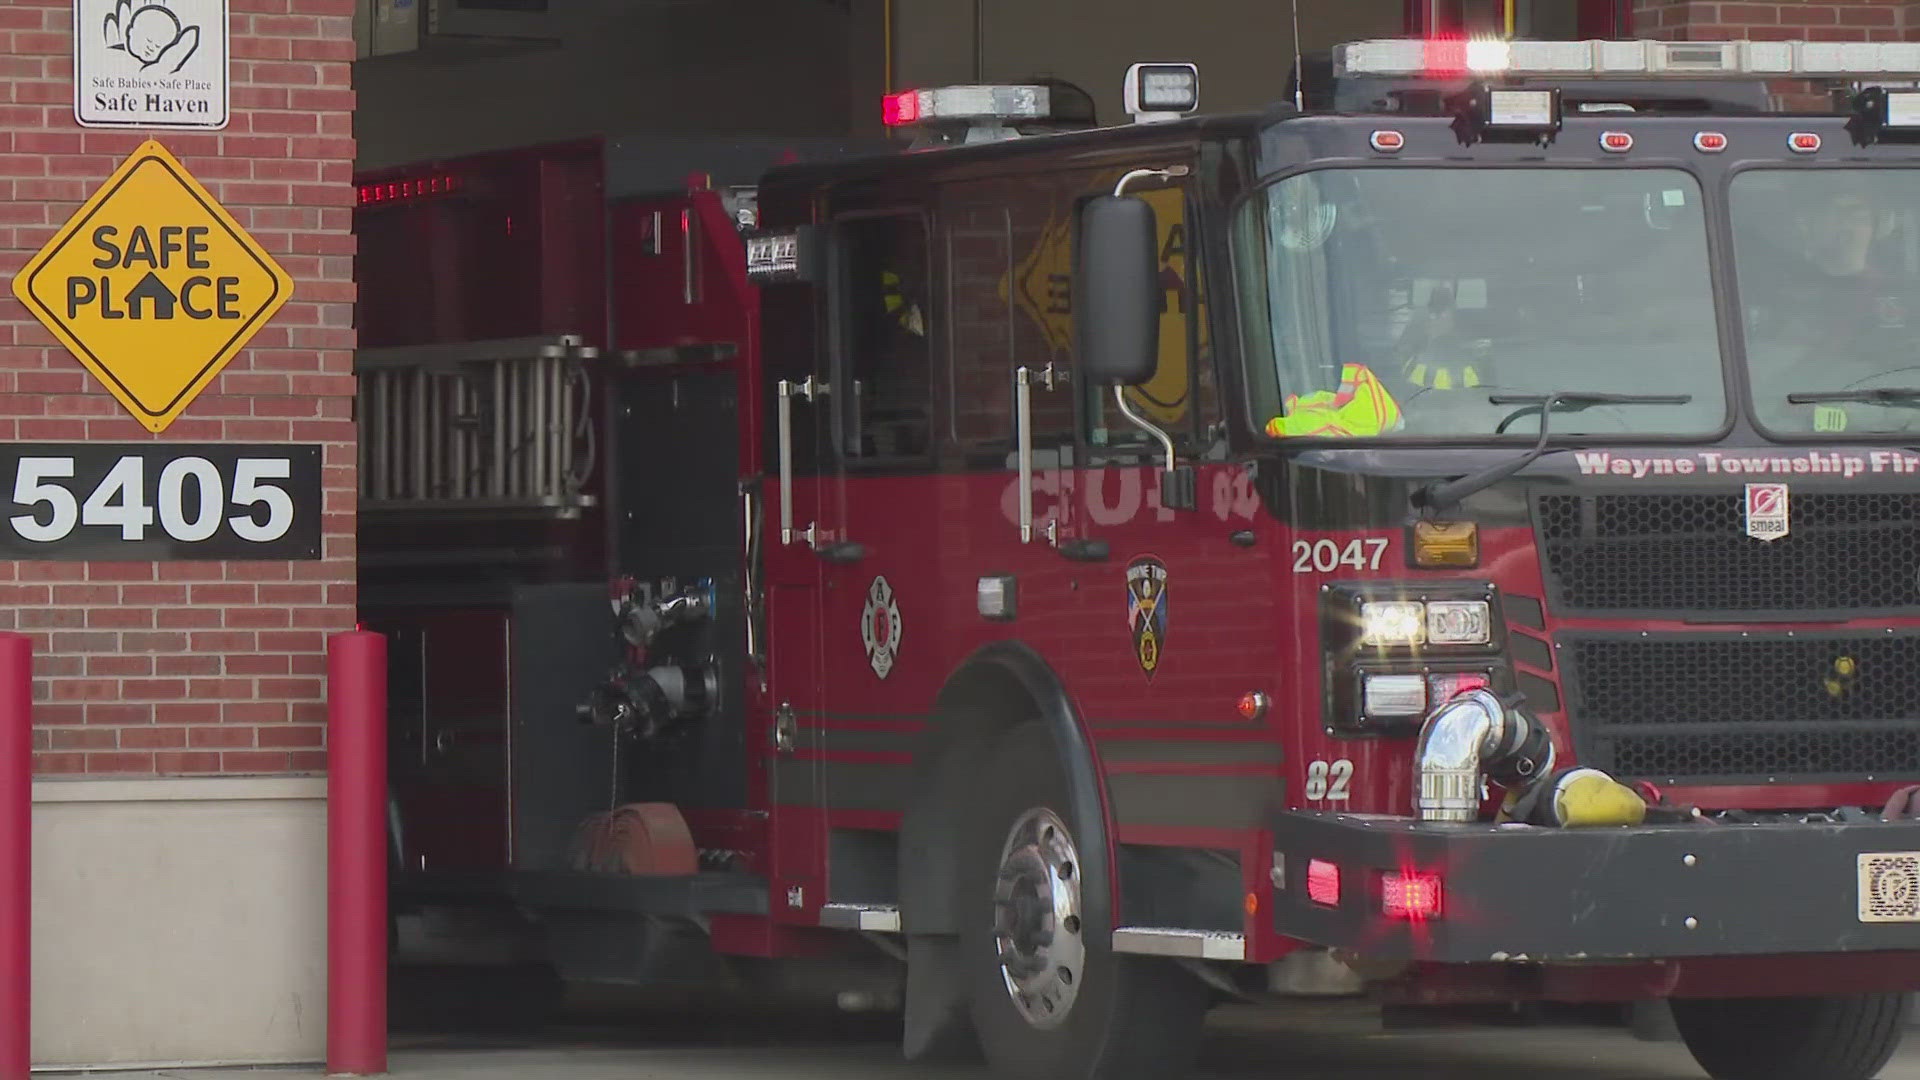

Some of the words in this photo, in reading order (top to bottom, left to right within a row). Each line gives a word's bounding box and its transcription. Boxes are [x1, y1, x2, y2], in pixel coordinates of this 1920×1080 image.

[92, 77, 114, 89] Safe
[118, 77, 151, 89] Babies
[159, 78, 182, 90] Safe
[185, 79, 212, 91] Place
[94, 92, 138, 113] Safe
[145, 93, 209, 114] Haven
[92, 225, 210, 269] SAFE
[1575, 452, 1697, 478] Wayne
[1698, 451, 1866, 478] Township
[9, 455, 295, 542] 5405
[1750, 519, 1785, 532] smeal
[1292, 537, 1389, 573] 2047
[1306, 758, 1354, 801] 82
